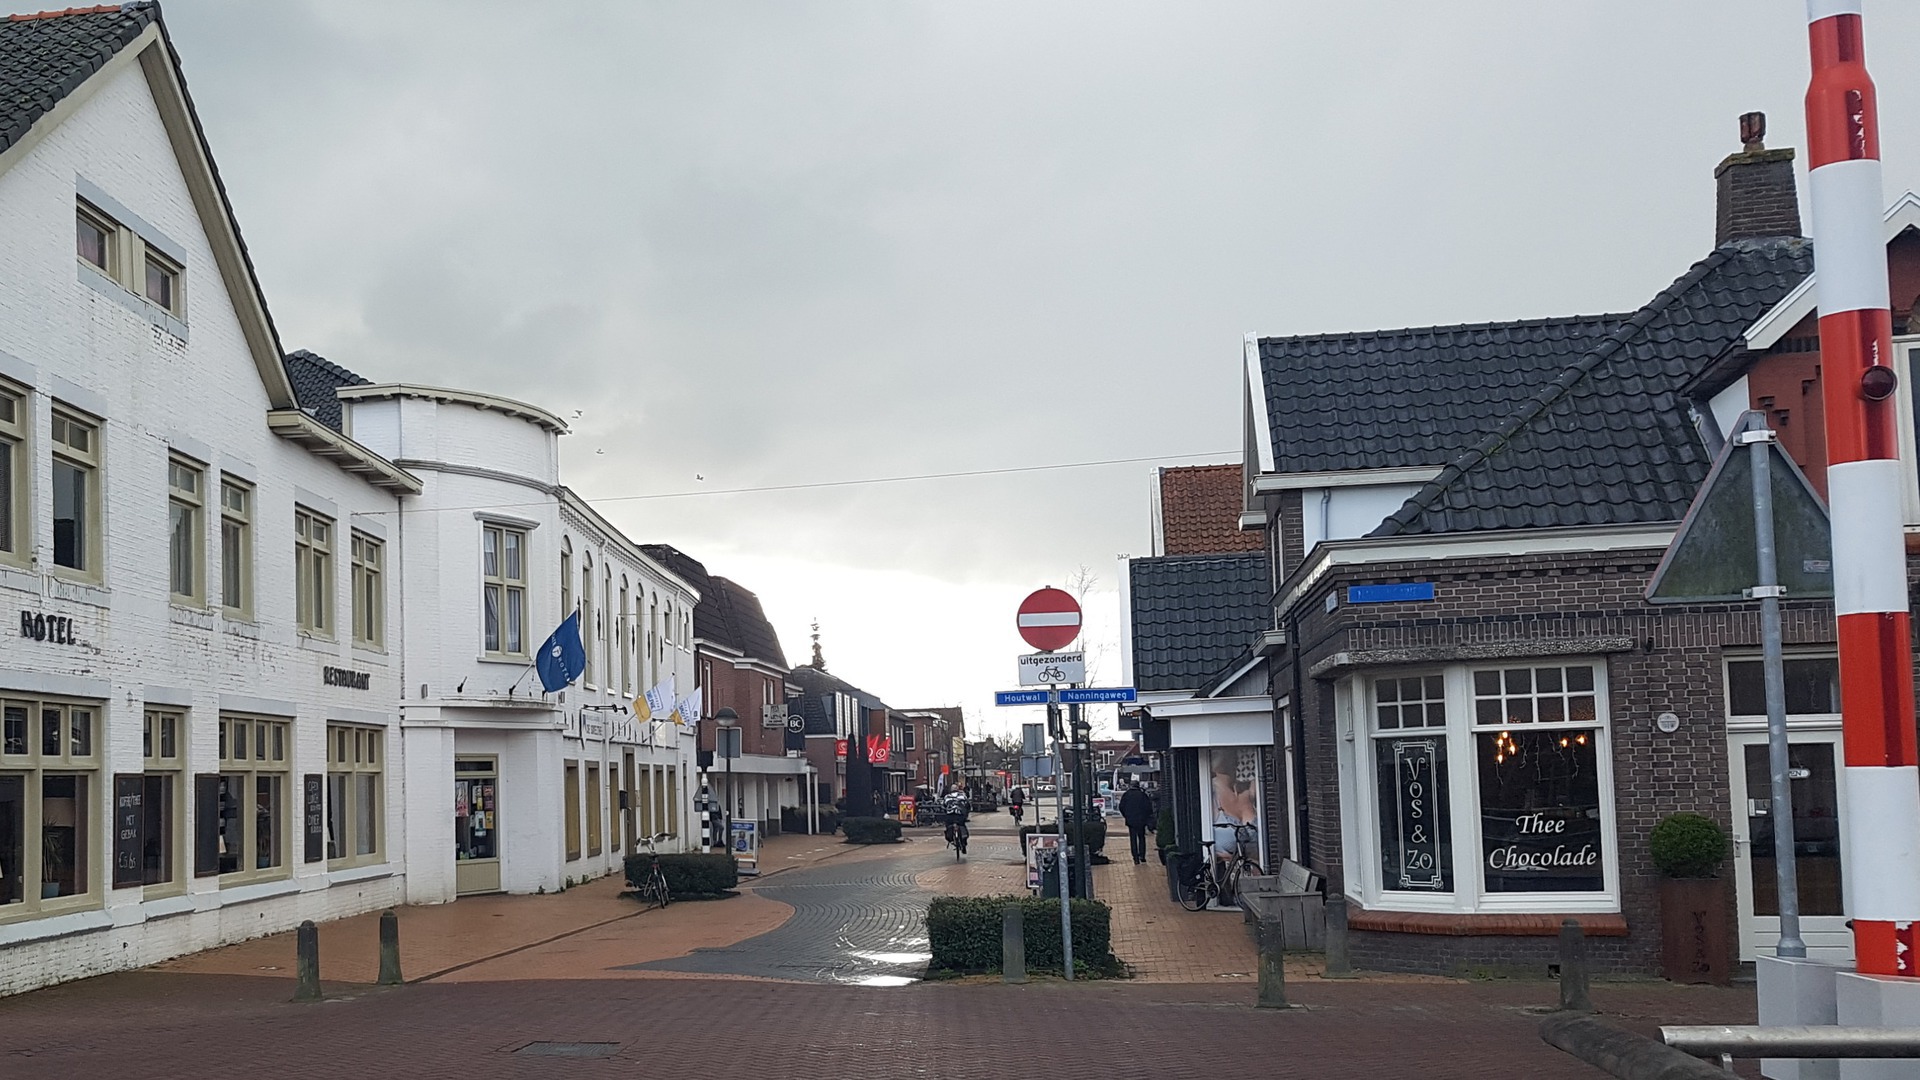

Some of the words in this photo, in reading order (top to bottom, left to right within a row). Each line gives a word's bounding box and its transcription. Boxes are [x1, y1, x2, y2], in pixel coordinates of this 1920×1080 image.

[21, 610, 76, 645] HOTEL
[1020, 653, 1082, 667] uitgezonderd
[323, 665, 370, 690] RESTAURANT
[1004, 693, 1040, 702] Houtwal
[1067, 690, 1127, 701] Nanningaweg
[1404, 757, 1426, 819] VOS
[1411, 824, 1427, 843] &
[1516, 812, 1565, 834] Thee
[1406, 849, 1433, 870] ZO
[1489, 844, 1597, 869] Chocolade
